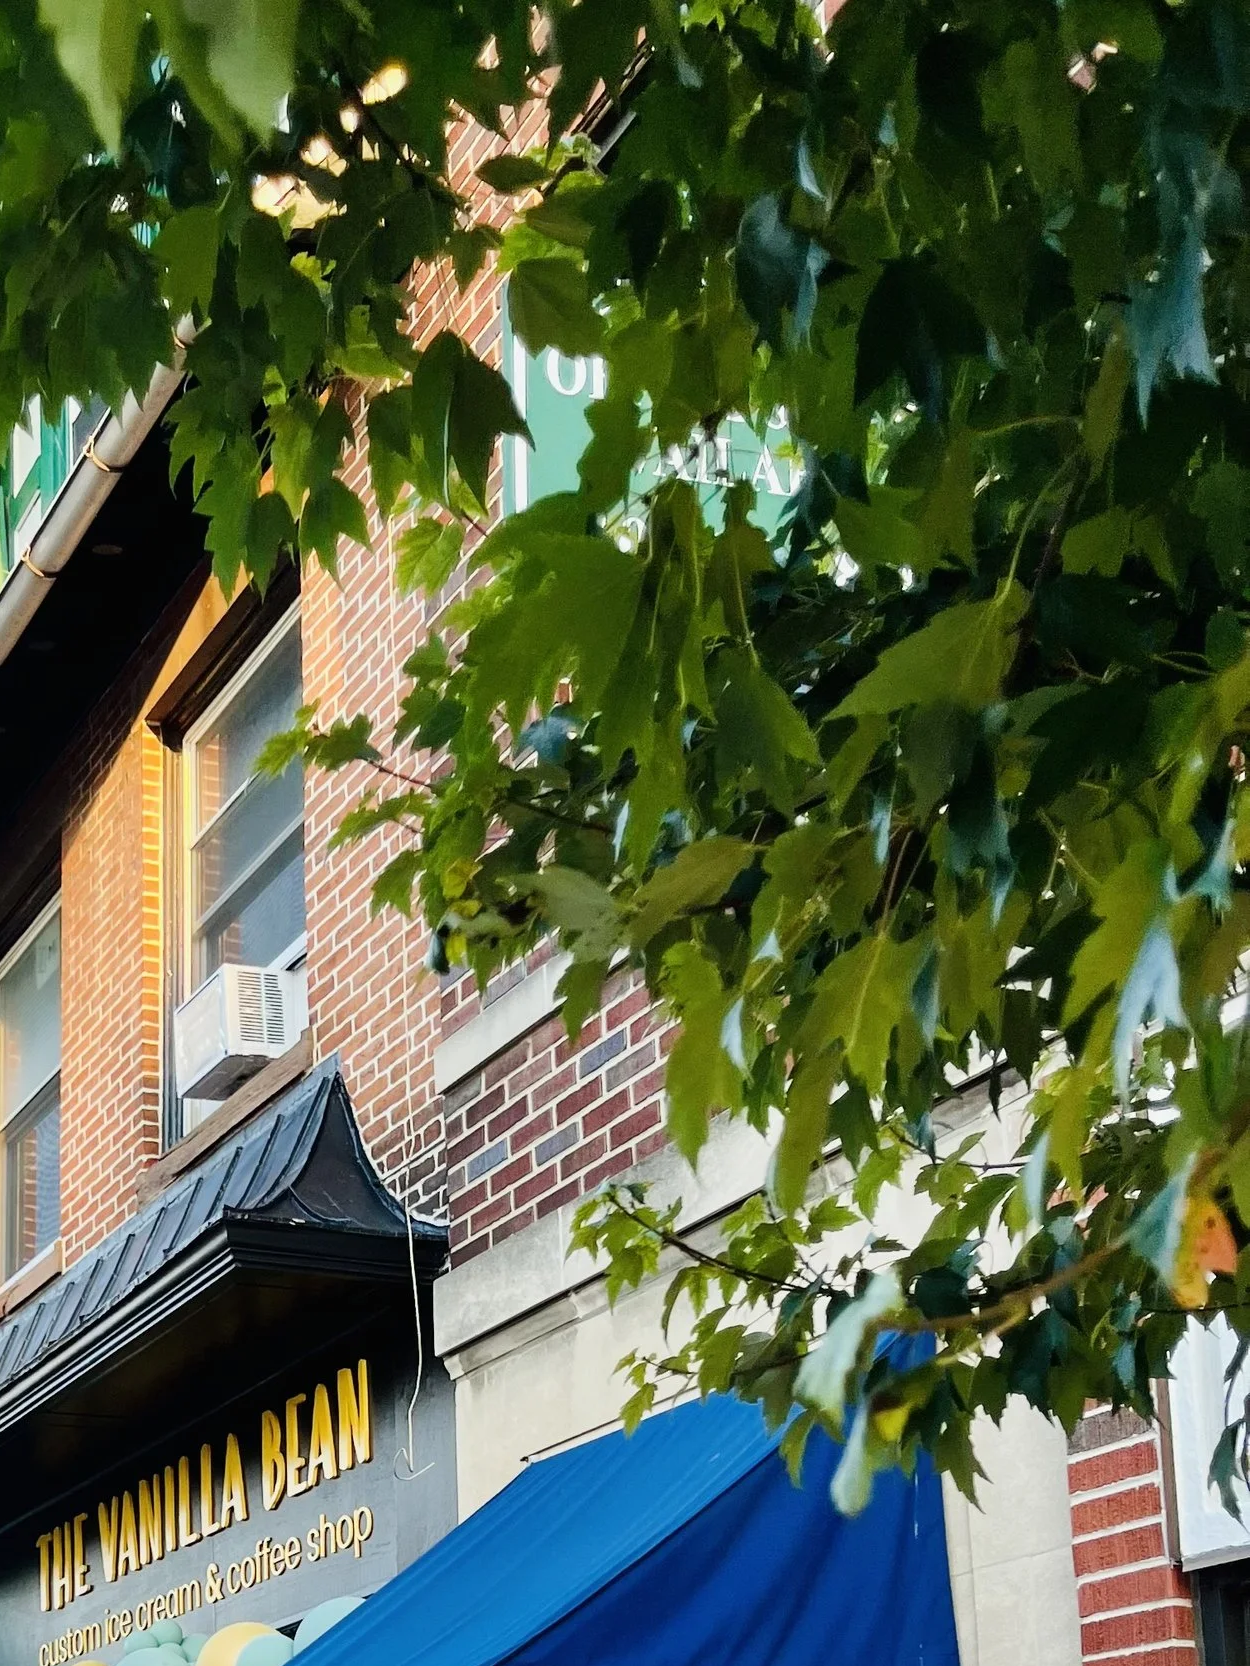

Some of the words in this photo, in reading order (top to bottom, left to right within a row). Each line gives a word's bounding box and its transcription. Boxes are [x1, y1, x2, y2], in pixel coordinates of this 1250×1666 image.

[36, 1512, 93, 1613] THE
[98, 1432, 249, 1583] VANILLA
[261, 1358, 372, 1512] BEAN
[104, 1608, 133, 1642] ice
[135, 1579, 202, 1631] cream
[204, 1562, 225, 1604] &
[226, 1536, 302, 1594] coffee
[306, 1505, 373, 1563] shop
